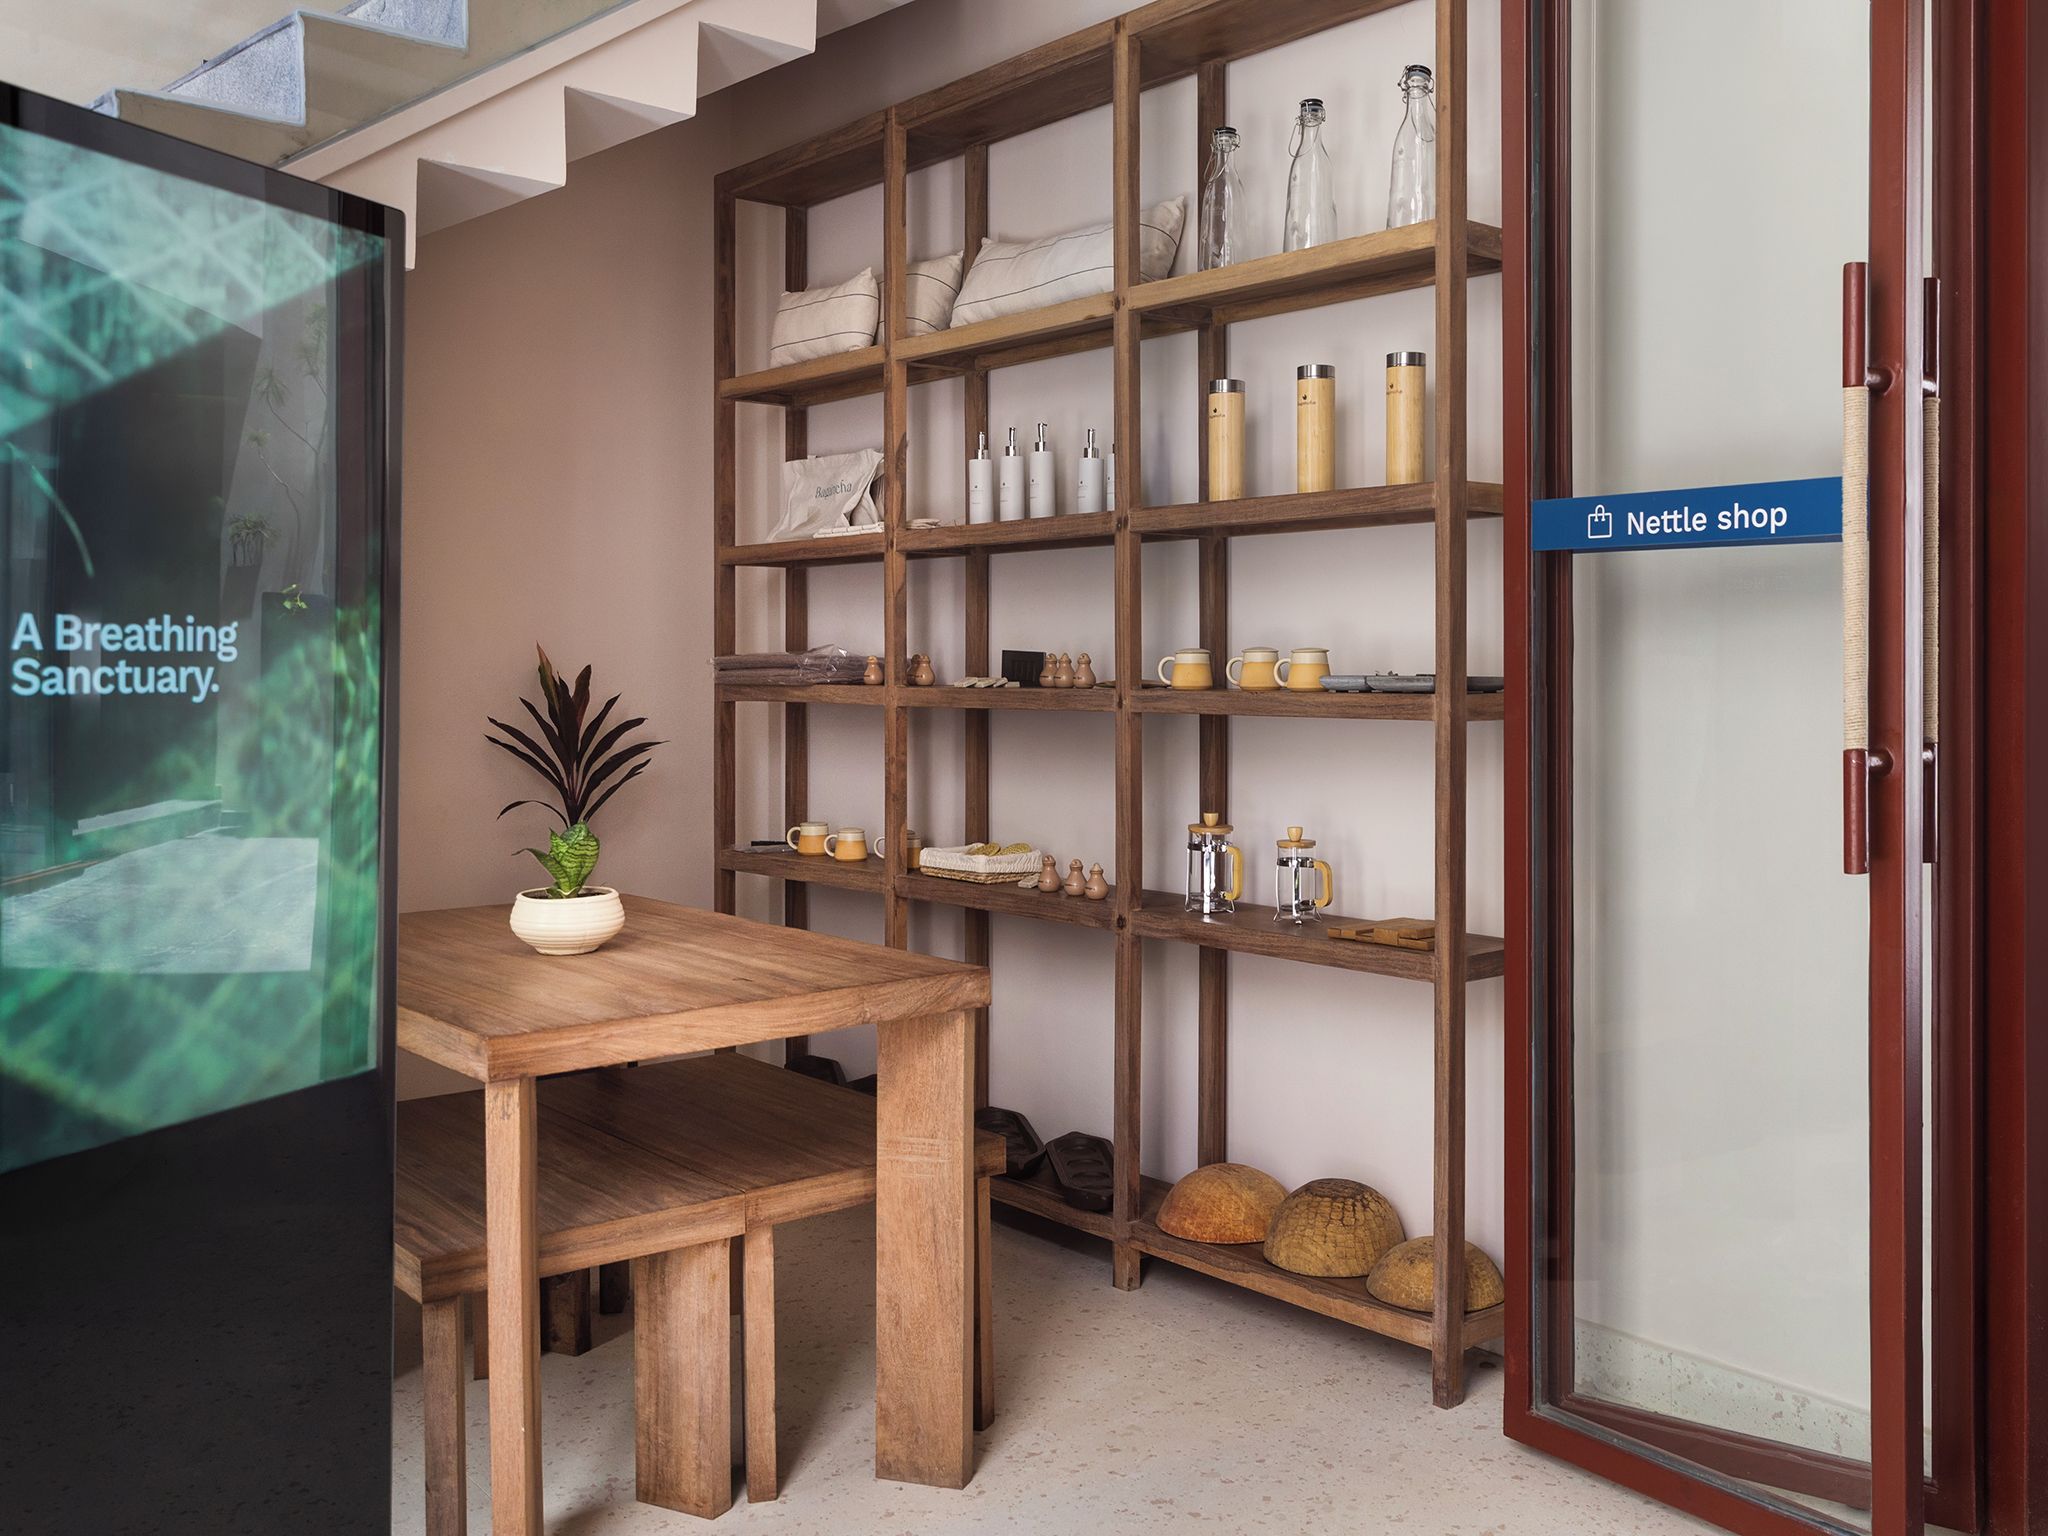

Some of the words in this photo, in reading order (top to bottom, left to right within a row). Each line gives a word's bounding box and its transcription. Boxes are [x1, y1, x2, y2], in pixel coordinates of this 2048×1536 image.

[1627, 506, 1707, 536] Nettle
[1717, 502, 1788, 534] shop
[11, 612, 44, 651] A
[55, 613, 239, 662] Breathing
[11, 657, 220, 703] Sanctuary.
